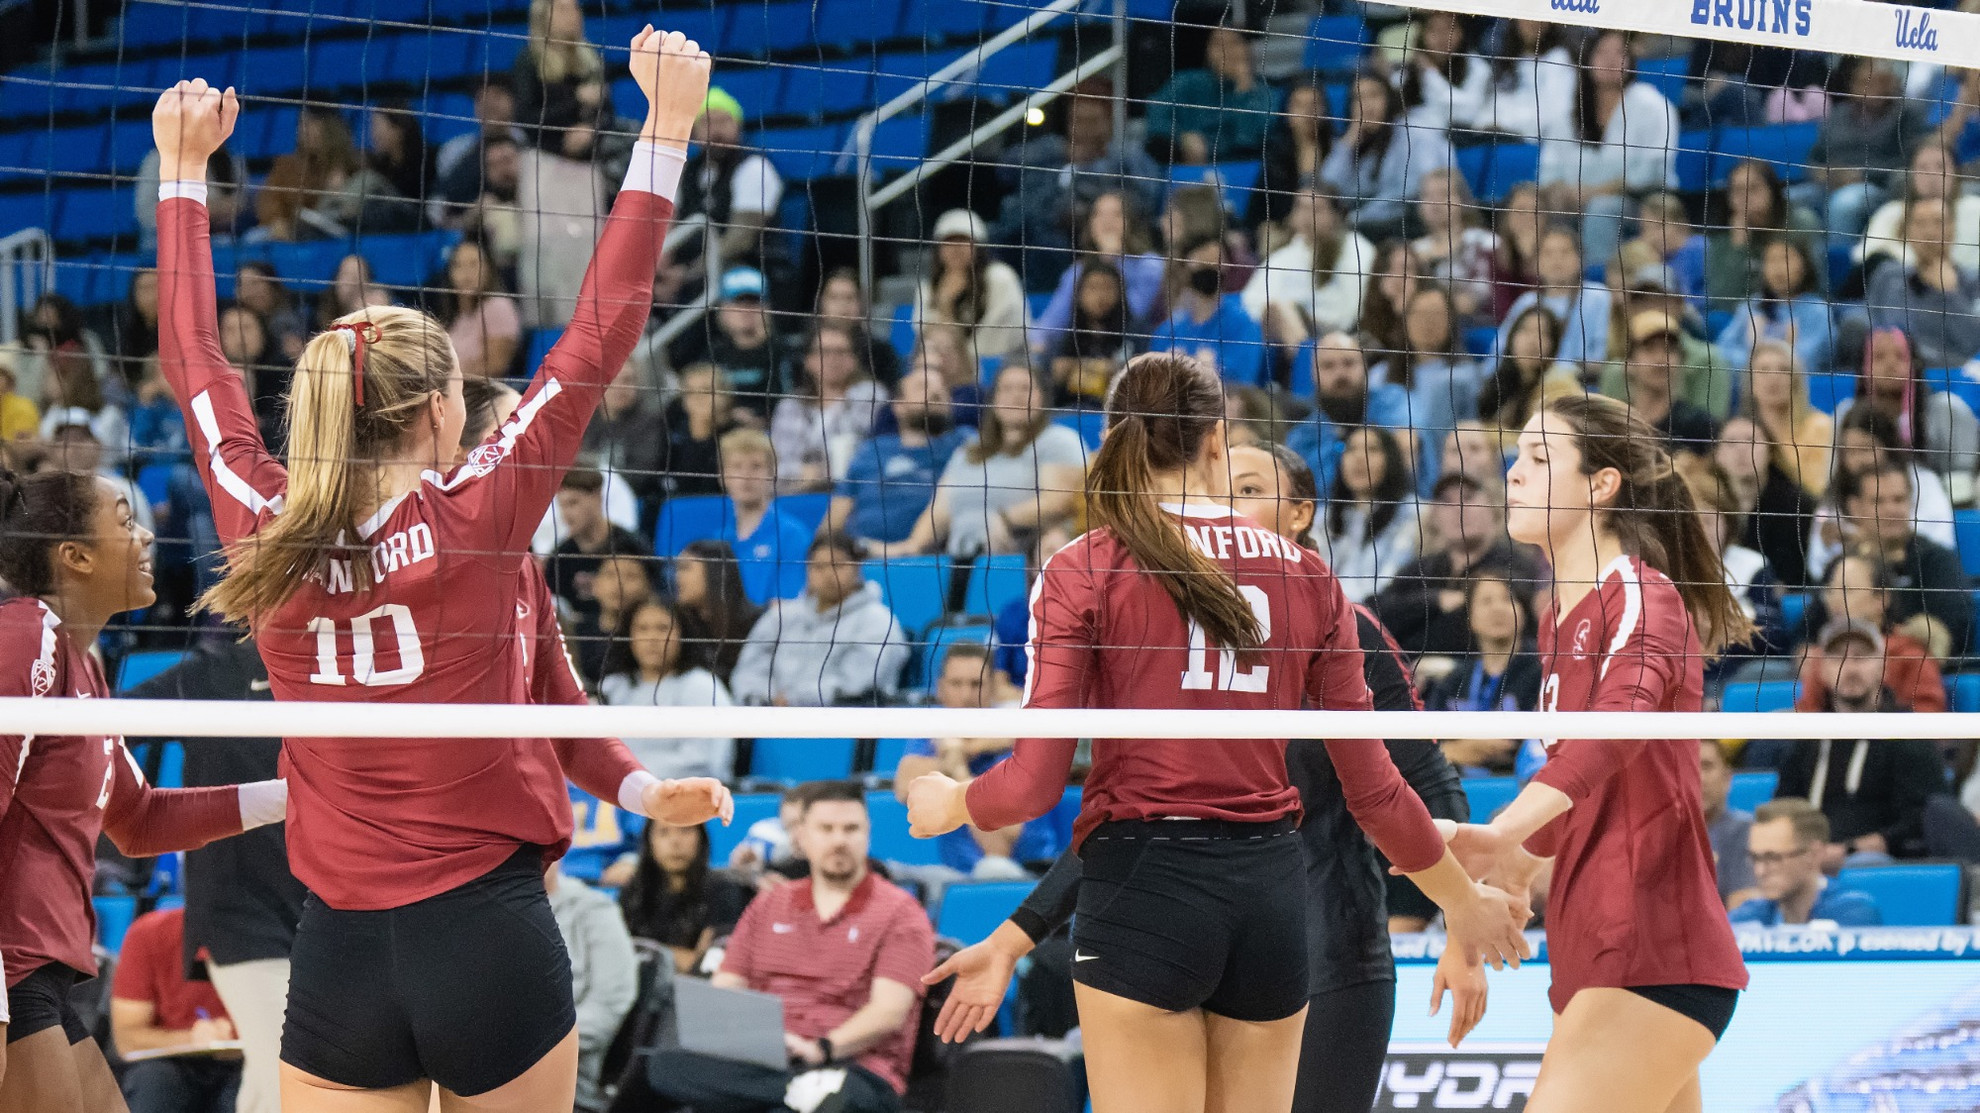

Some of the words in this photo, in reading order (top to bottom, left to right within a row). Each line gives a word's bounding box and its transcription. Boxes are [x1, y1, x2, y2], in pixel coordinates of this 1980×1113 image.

[1690, 0, 1812, 37] BRUINS
[1895, 9, 1939, 51] Ucla
[1182, 525, 1302, 563] NFORD
[307, 603, 426, 687] 10
[1181, 585, 1272, 693] 12
